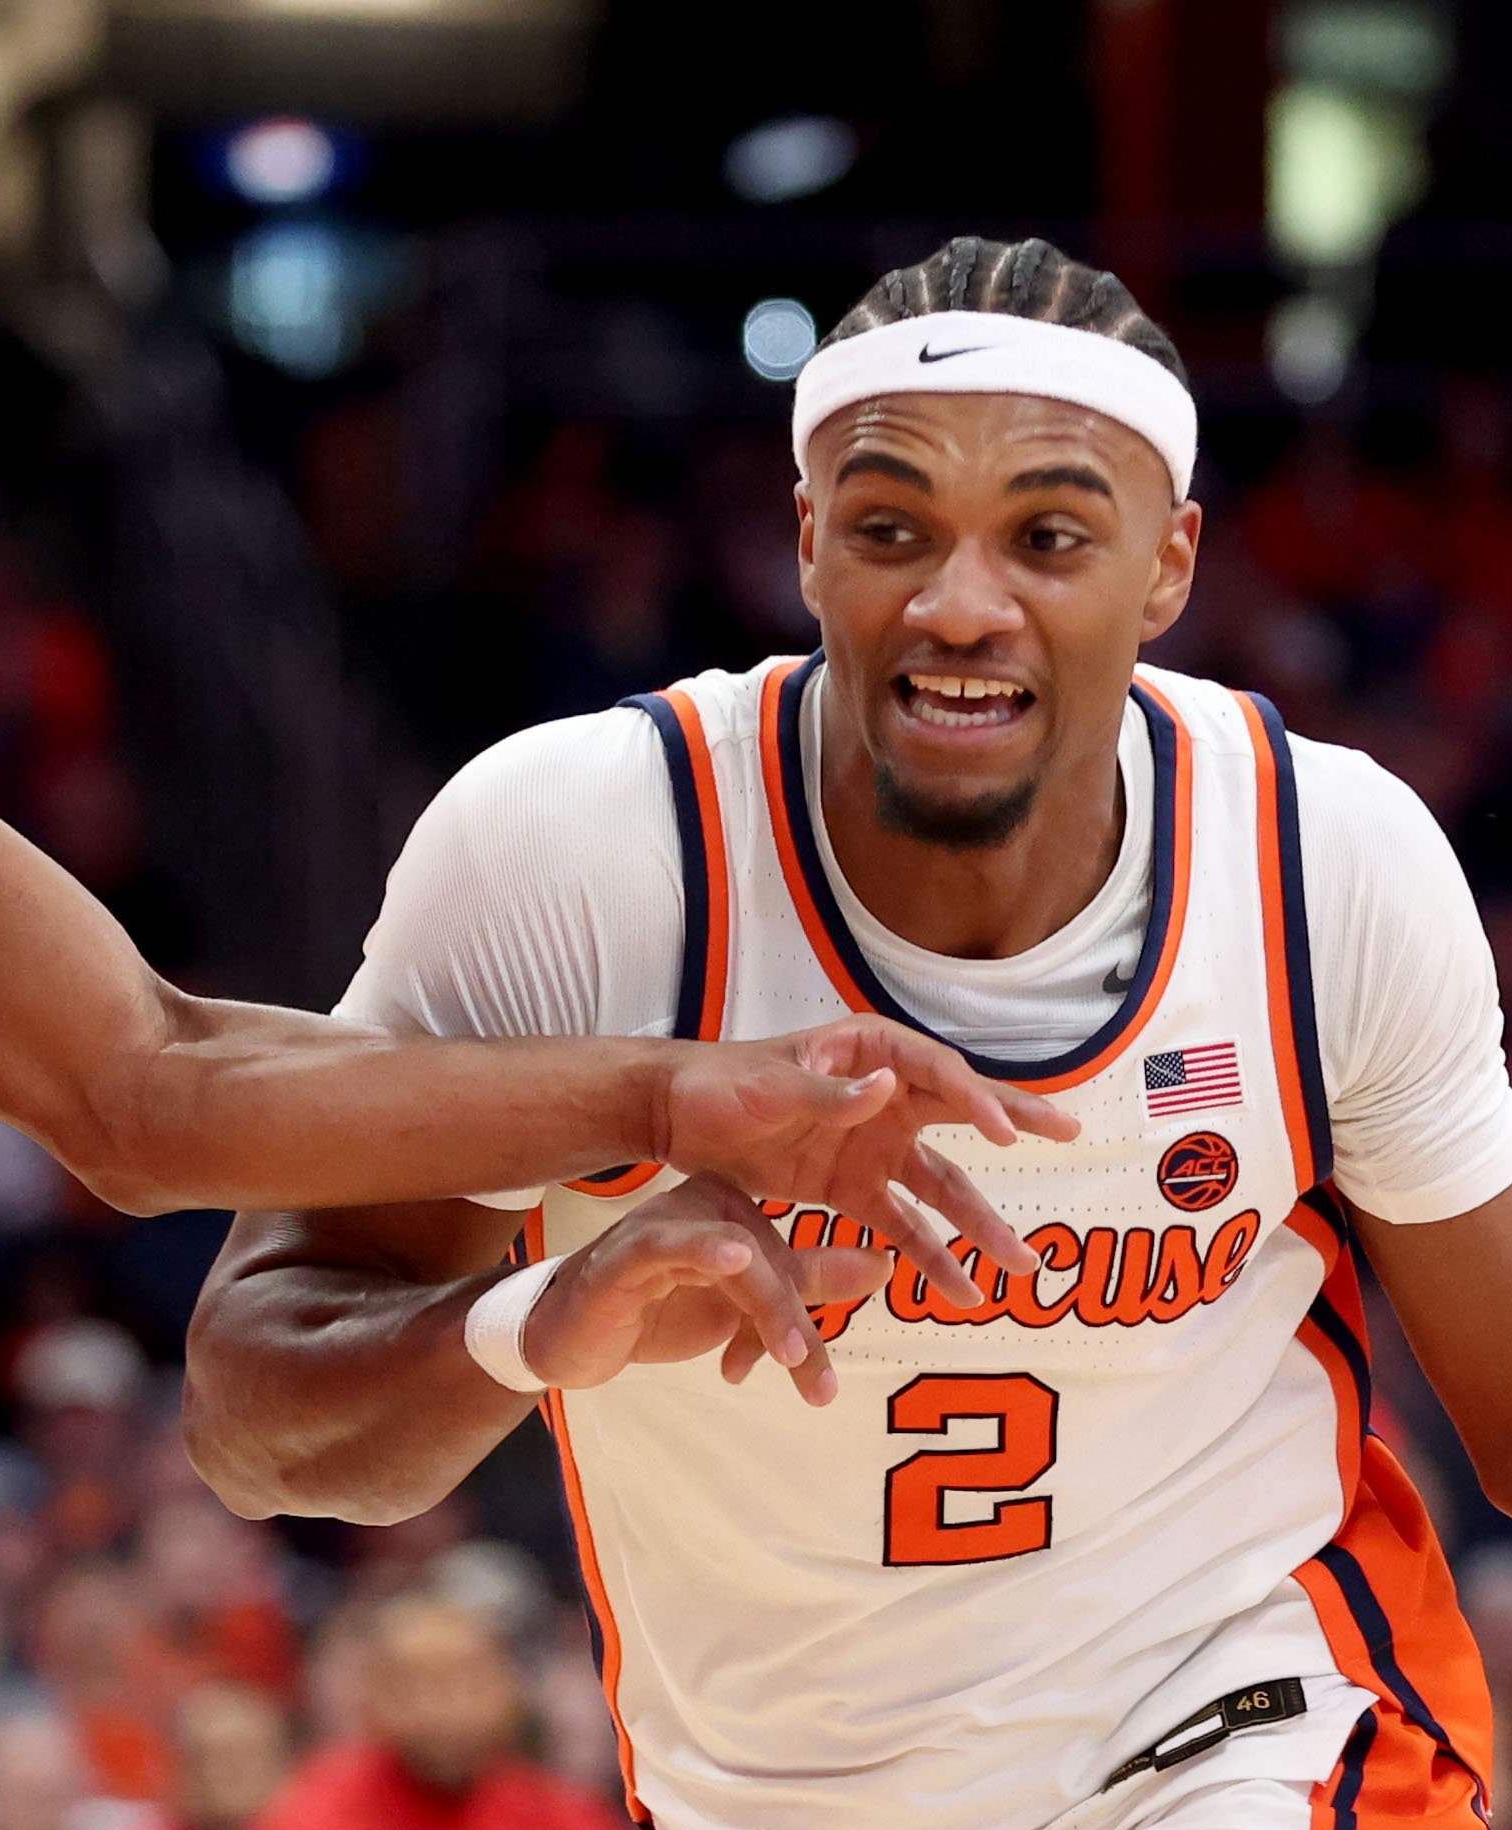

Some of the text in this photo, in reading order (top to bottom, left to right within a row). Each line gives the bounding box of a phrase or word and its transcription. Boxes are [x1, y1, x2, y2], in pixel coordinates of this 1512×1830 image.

[1172, 1156, 1231, 1176] ACC
[758, 1200, 1261, 1342] yracuse
[883, 1371, 1059, 1567] 2
[1236, 1690, 1271, 1712] 46
